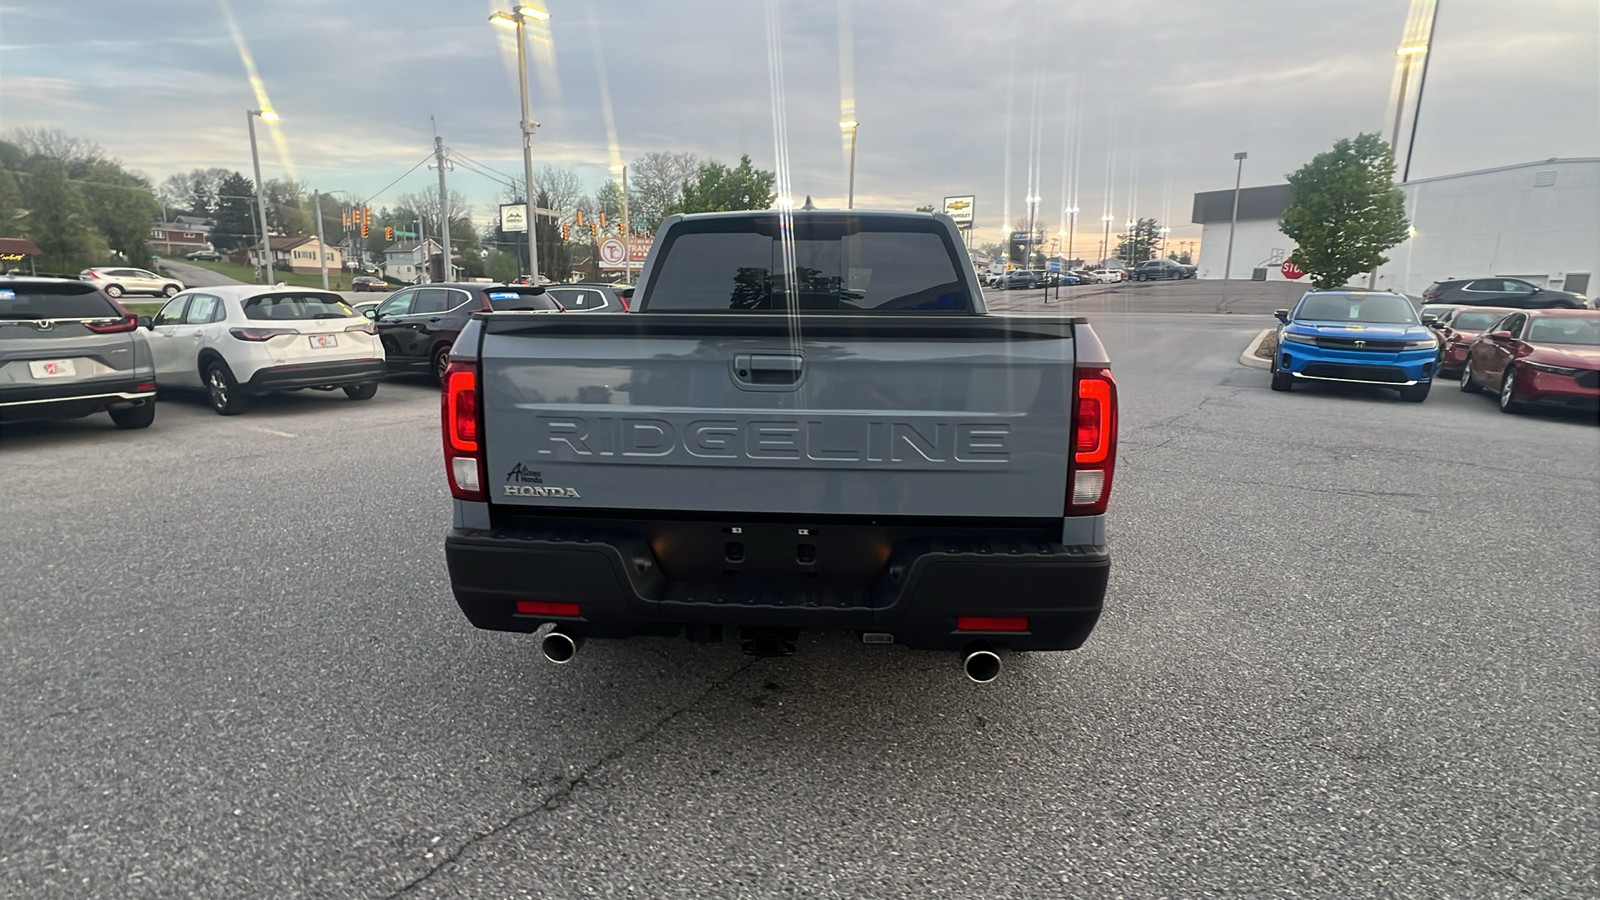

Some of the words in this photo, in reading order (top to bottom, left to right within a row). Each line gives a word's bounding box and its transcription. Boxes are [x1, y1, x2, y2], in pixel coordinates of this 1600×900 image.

[1283, 262, 1303, 273] STO
[536, 415, 1010, 464] RIDGELINE
[503, 485, 581, 499] HONDA
